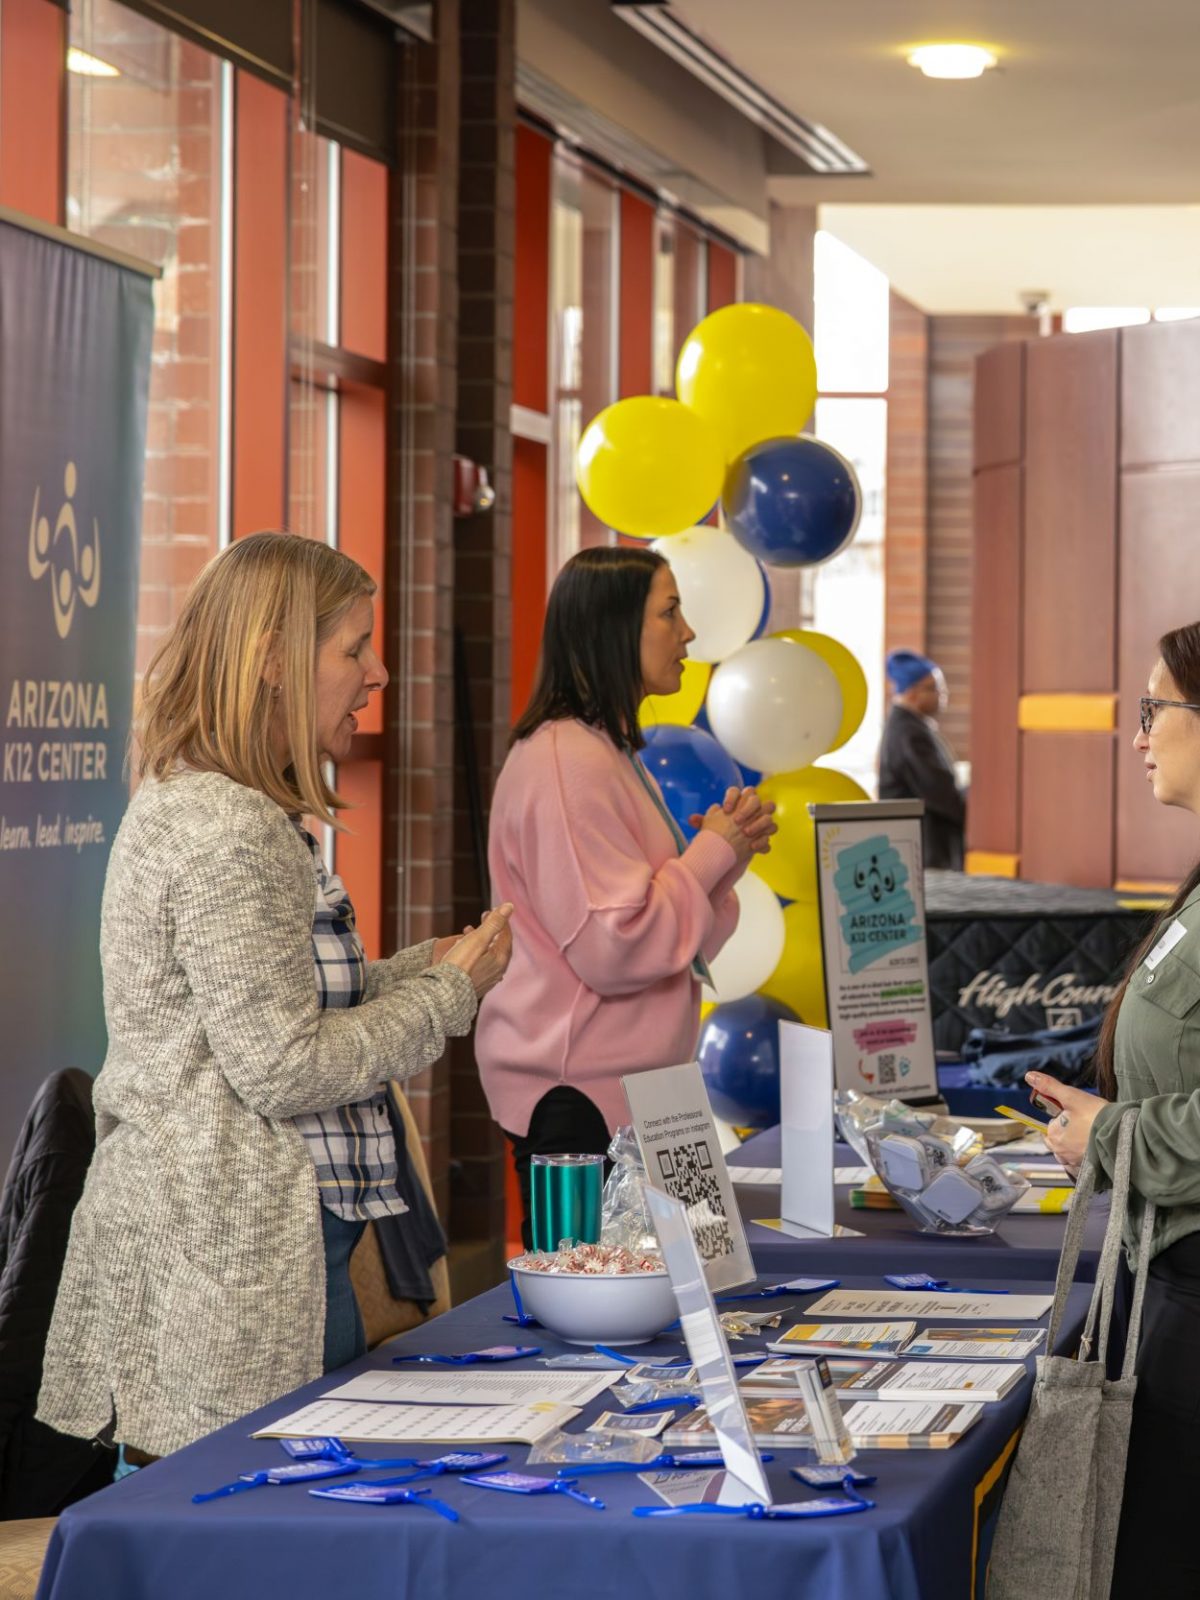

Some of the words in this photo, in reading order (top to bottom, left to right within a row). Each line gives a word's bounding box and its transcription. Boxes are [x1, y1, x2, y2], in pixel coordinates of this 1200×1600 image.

[6, 679, 110, 729] ARIZONA
[3, 742, 32, 783] K12
[38, 742, 107, 782] CENTER
[0, 815, 31, 851] learn.
[35, 812, 62, 848] lead.
[64, 813, 106, 854] inspire.
[850, 913, 906, 929] ARIZONA
[868, 929, 907, 942] CENTER
[958, 970, 1041, 1018] High
